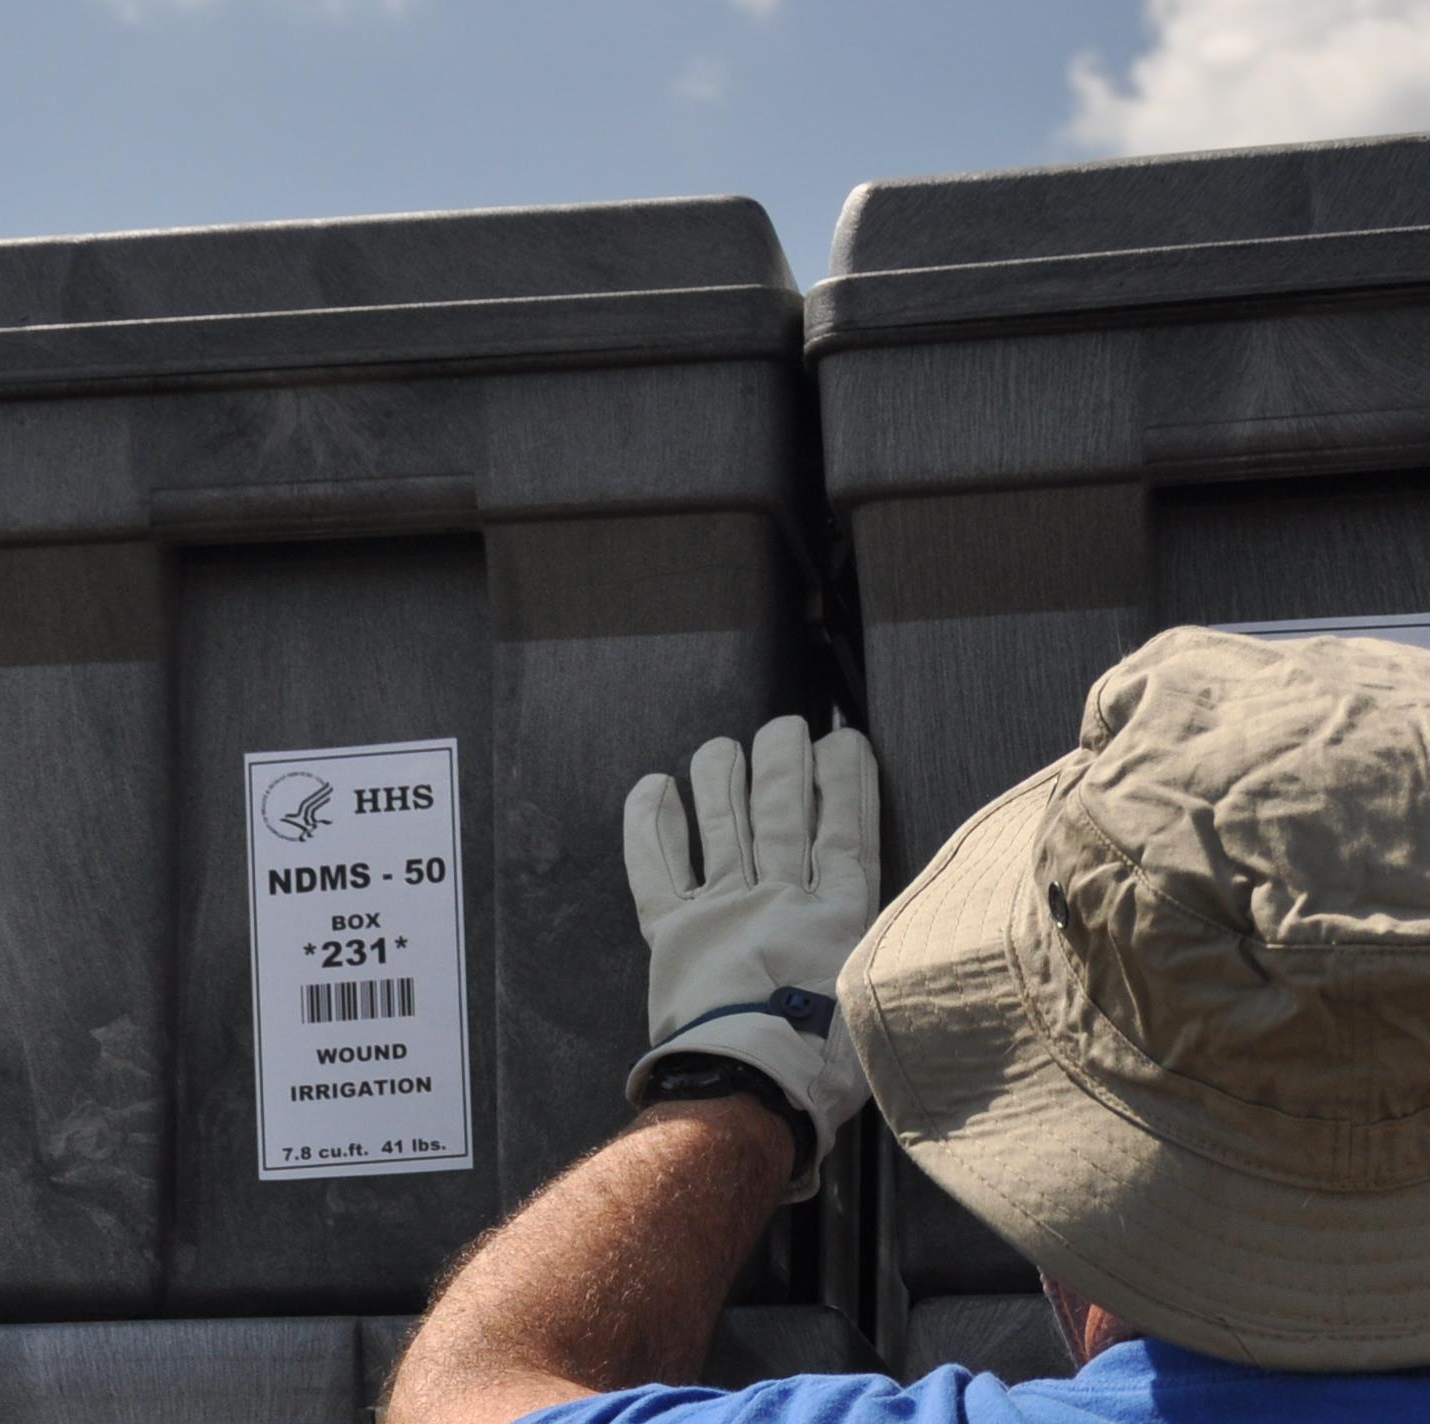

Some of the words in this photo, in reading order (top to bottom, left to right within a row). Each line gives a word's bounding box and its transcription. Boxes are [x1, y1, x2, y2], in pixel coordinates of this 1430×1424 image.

[353, 784, 434, 815] HHS
[268, 862, 372, 896] NDMS
[404, 856, 446, 886] 50
[331, 912, 381, 932] BOX
[316, 1043, 408, 1065] WOUND
[290, 1076, 432, 1102] IRRIGATION
[282, 1146, 312, 1162] 7.8
[318, 1142, 369, 1159] cu.ft.
[381, 1139, 403, 1154] 41
[411, 1138, 447, 1153] lbs.
